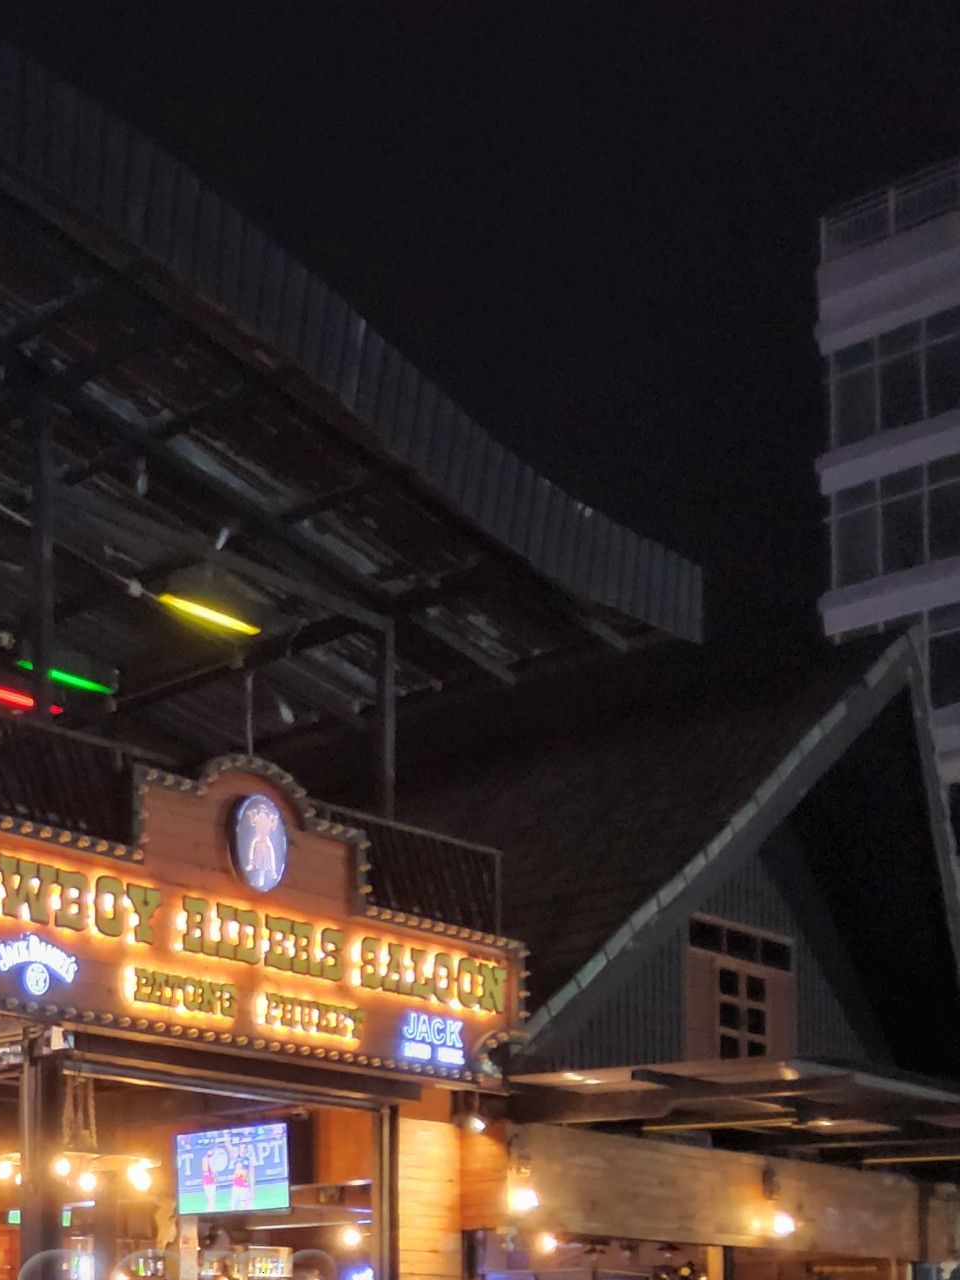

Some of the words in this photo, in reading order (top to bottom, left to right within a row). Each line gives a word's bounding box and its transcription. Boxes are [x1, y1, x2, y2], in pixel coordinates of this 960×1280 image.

[182, 896, 344, 982] RIDERS
[361, 936, 507, 1015] SALOON
[134, 966, 235, 1018] PATONG
[265, 992, 366, 1042] PHUKET
[401, 1012, 464, 1049] JACK
